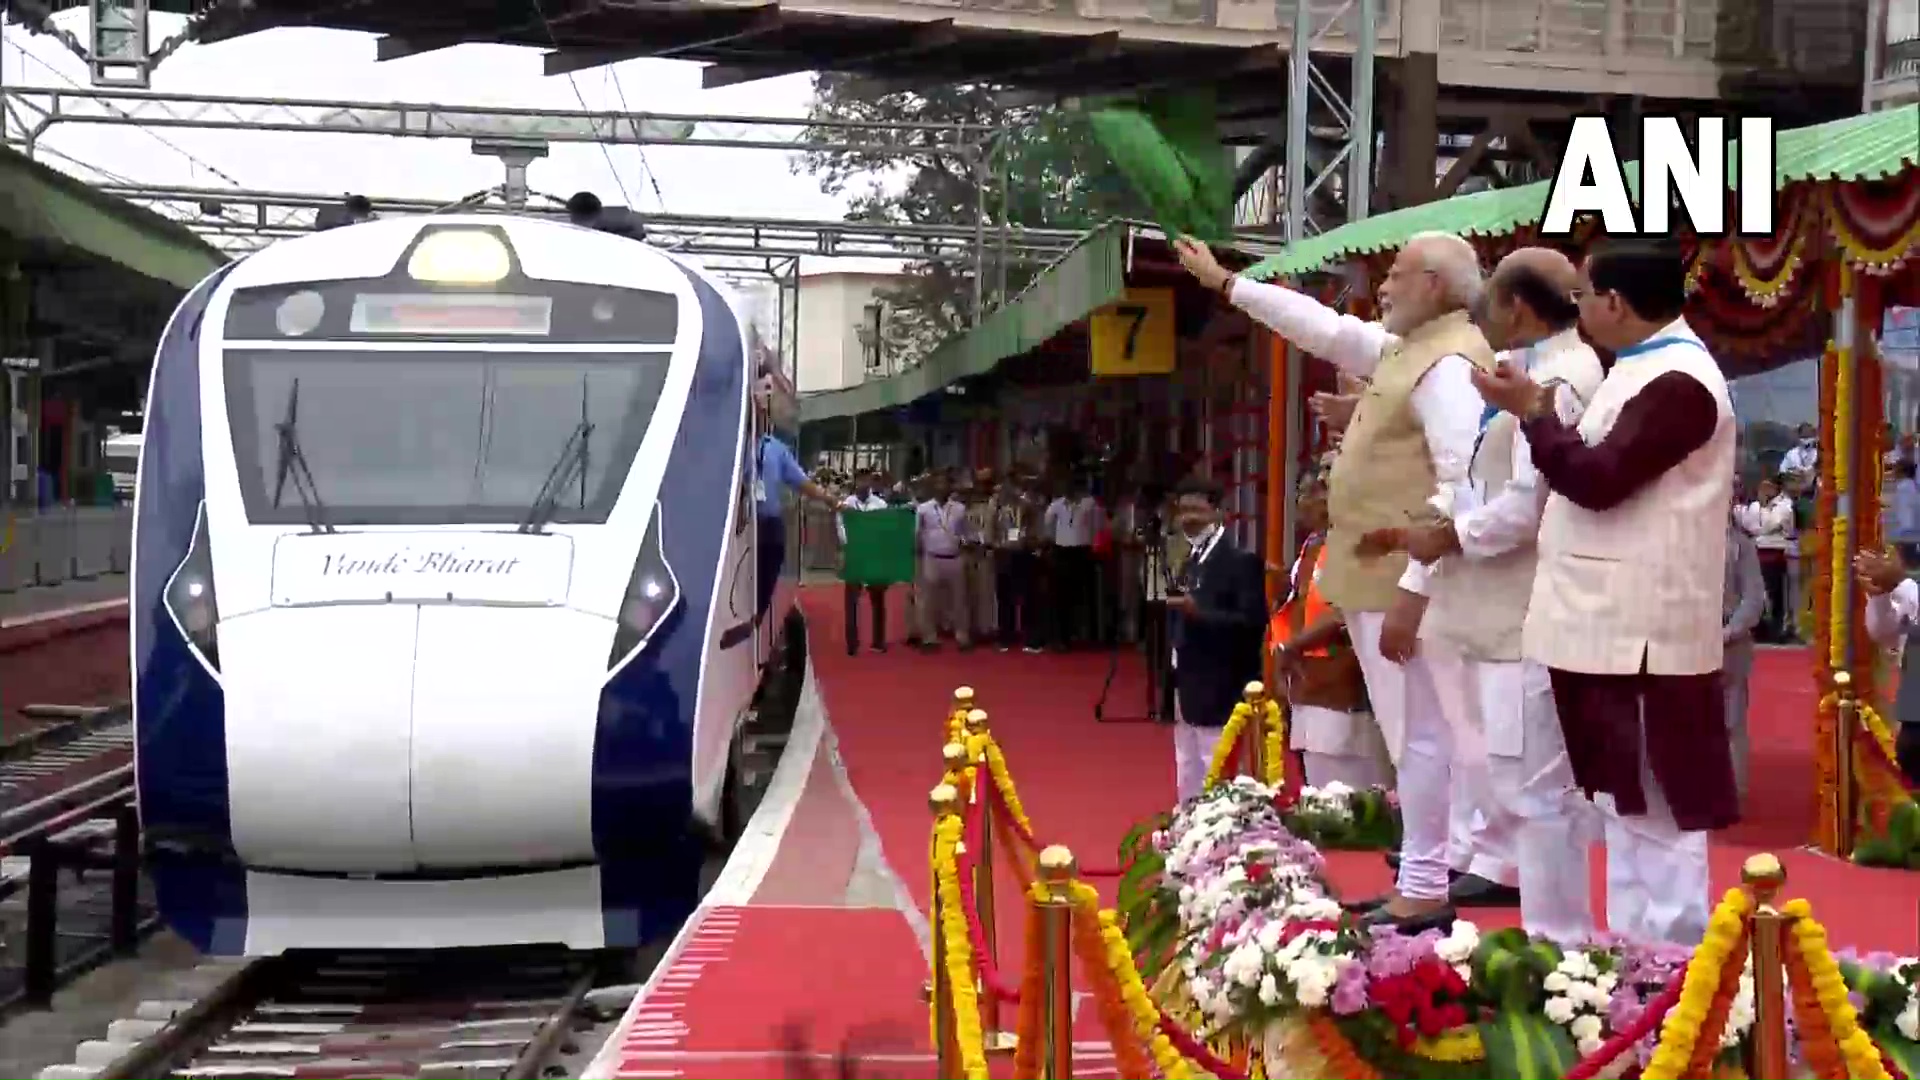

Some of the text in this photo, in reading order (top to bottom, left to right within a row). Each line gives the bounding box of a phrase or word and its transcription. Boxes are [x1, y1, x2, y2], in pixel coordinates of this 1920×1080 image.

[1116, 306, 1148, 361] 7
[322, 551, 520, 575] Vande Bharat
